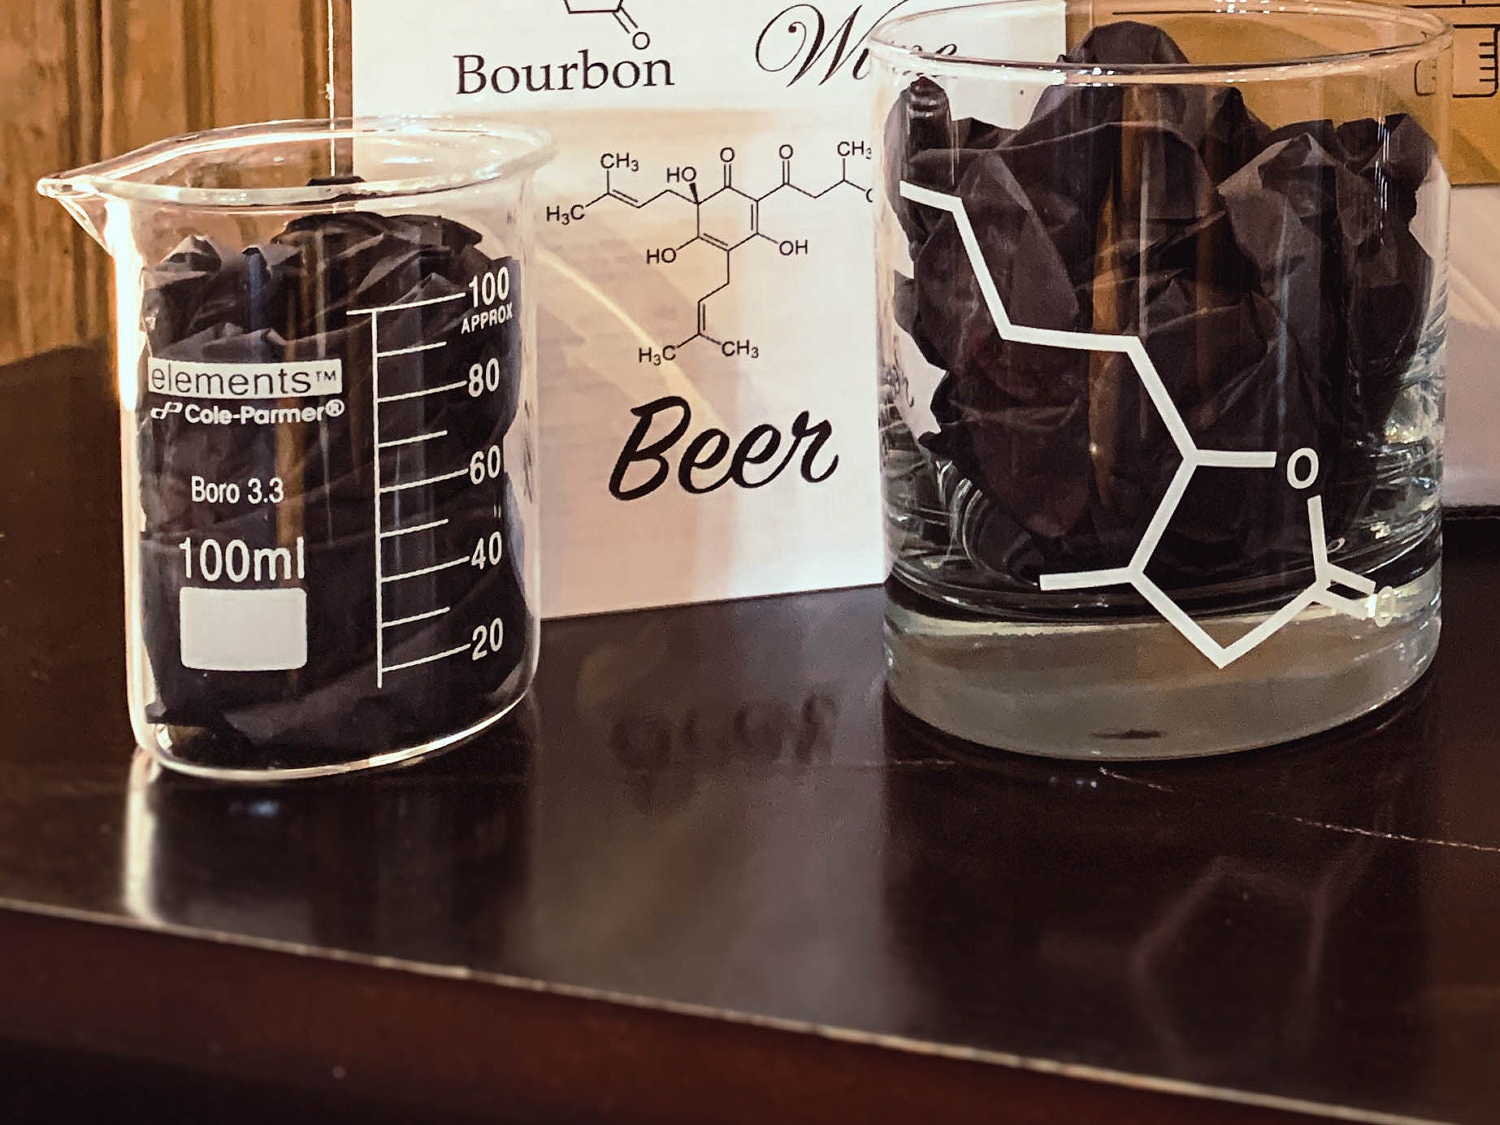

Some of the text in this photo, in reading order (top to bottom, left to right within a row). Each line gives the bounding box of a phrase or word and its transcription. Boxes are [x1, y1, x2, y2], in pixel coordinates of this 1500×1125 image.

[453, 49, 675, 96] Bourbon
[666, 166, 697, 183] HO
[646, 248, 677, 264] HO
[779, 240, 808, 256] OH
[468, 266, 509, 308] 100
[461, 301, 513, 335] APPROX
[467, 357, 500, 398] 80
[469, 445, 501, 484] 60
[608, 396, 839, 501] Beer
[191, 476, 284, 505] Boro 3.3
[178, 536, 305, 582] 100ml
[470, 531, 502, 571] 40
[471, 618, 504, 660] 20
